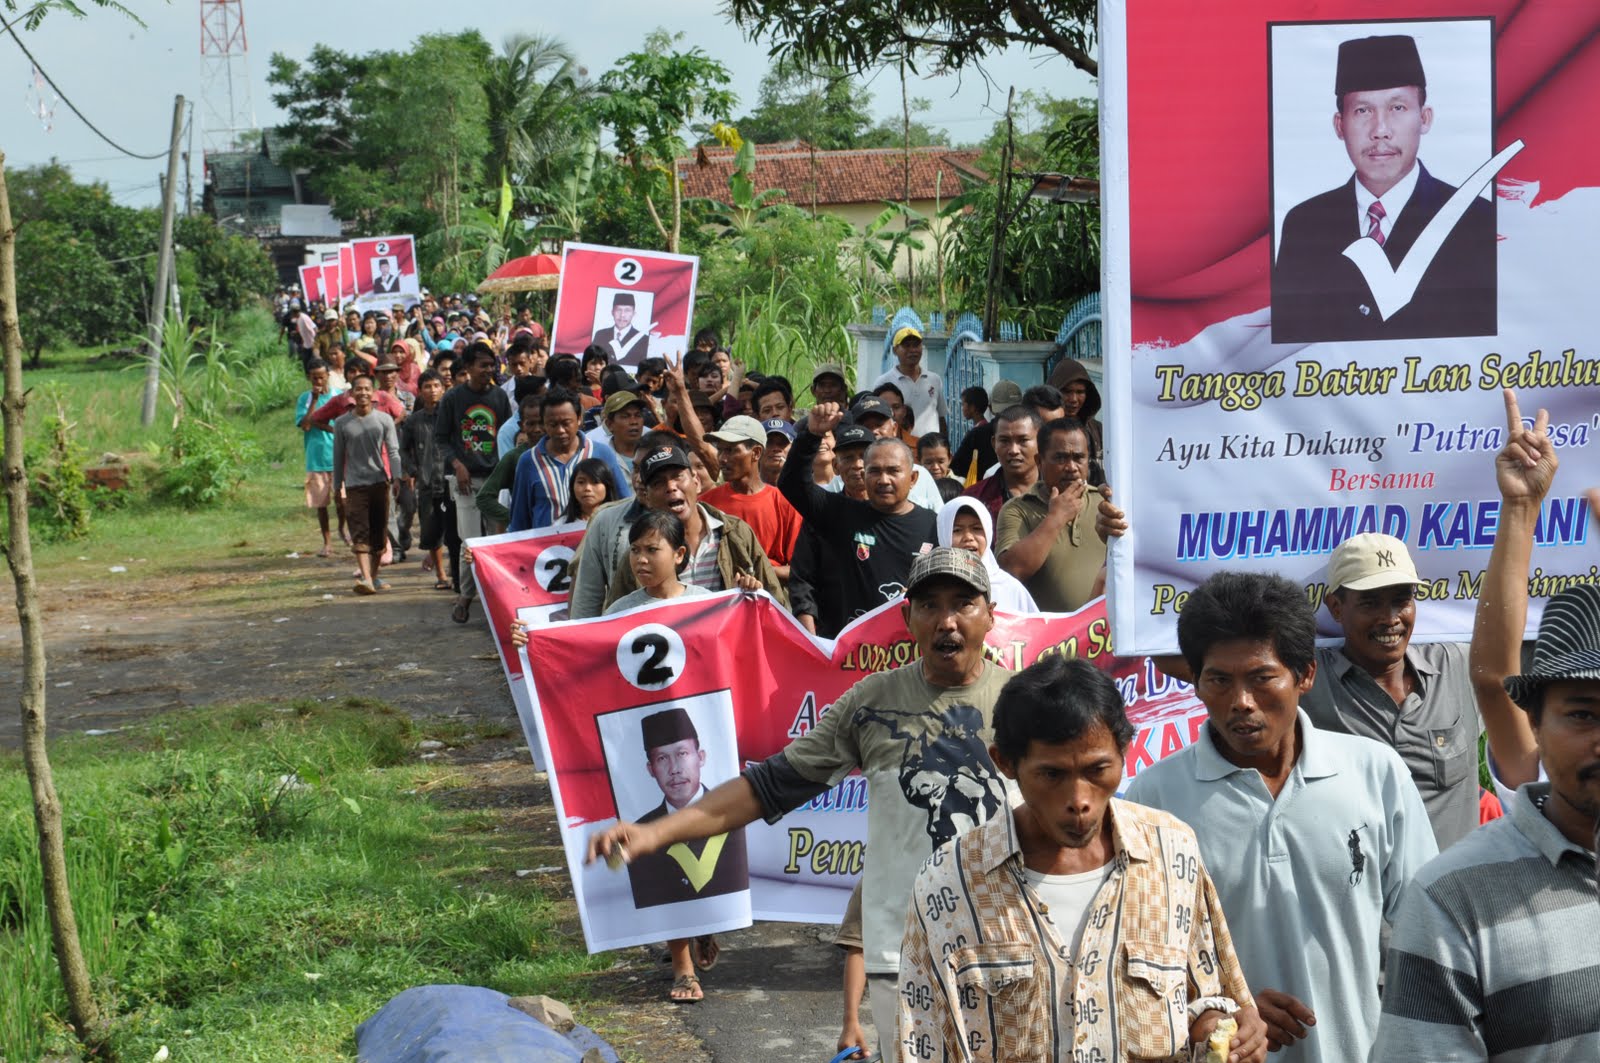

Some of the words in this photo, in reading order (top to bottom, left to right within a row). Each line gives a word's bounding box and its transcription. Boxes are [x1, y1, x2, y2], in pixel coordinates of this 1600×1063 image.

[378, 243, 386, 253] 2
[620, 261, 637, 281] 2
[1156, 364, 1286, 412] Tangga
[1293, 360, 1398, 398] Batur
[1402, 355, 1472, 394] Lan
[1156, 437, 1211, 470] Ayu
[1218, 434, 1276, 461] Kita
[1283, 430, 1387, 462] Dukung
[1397, 421, 1502, 453] "Putra
[1328, 467, 1436, 493] Bersama
[1176, 503, 1411, 562] MUHAMMAD
[544, 556, 570, 593] 2
[631, 632, 676, 686] 2
